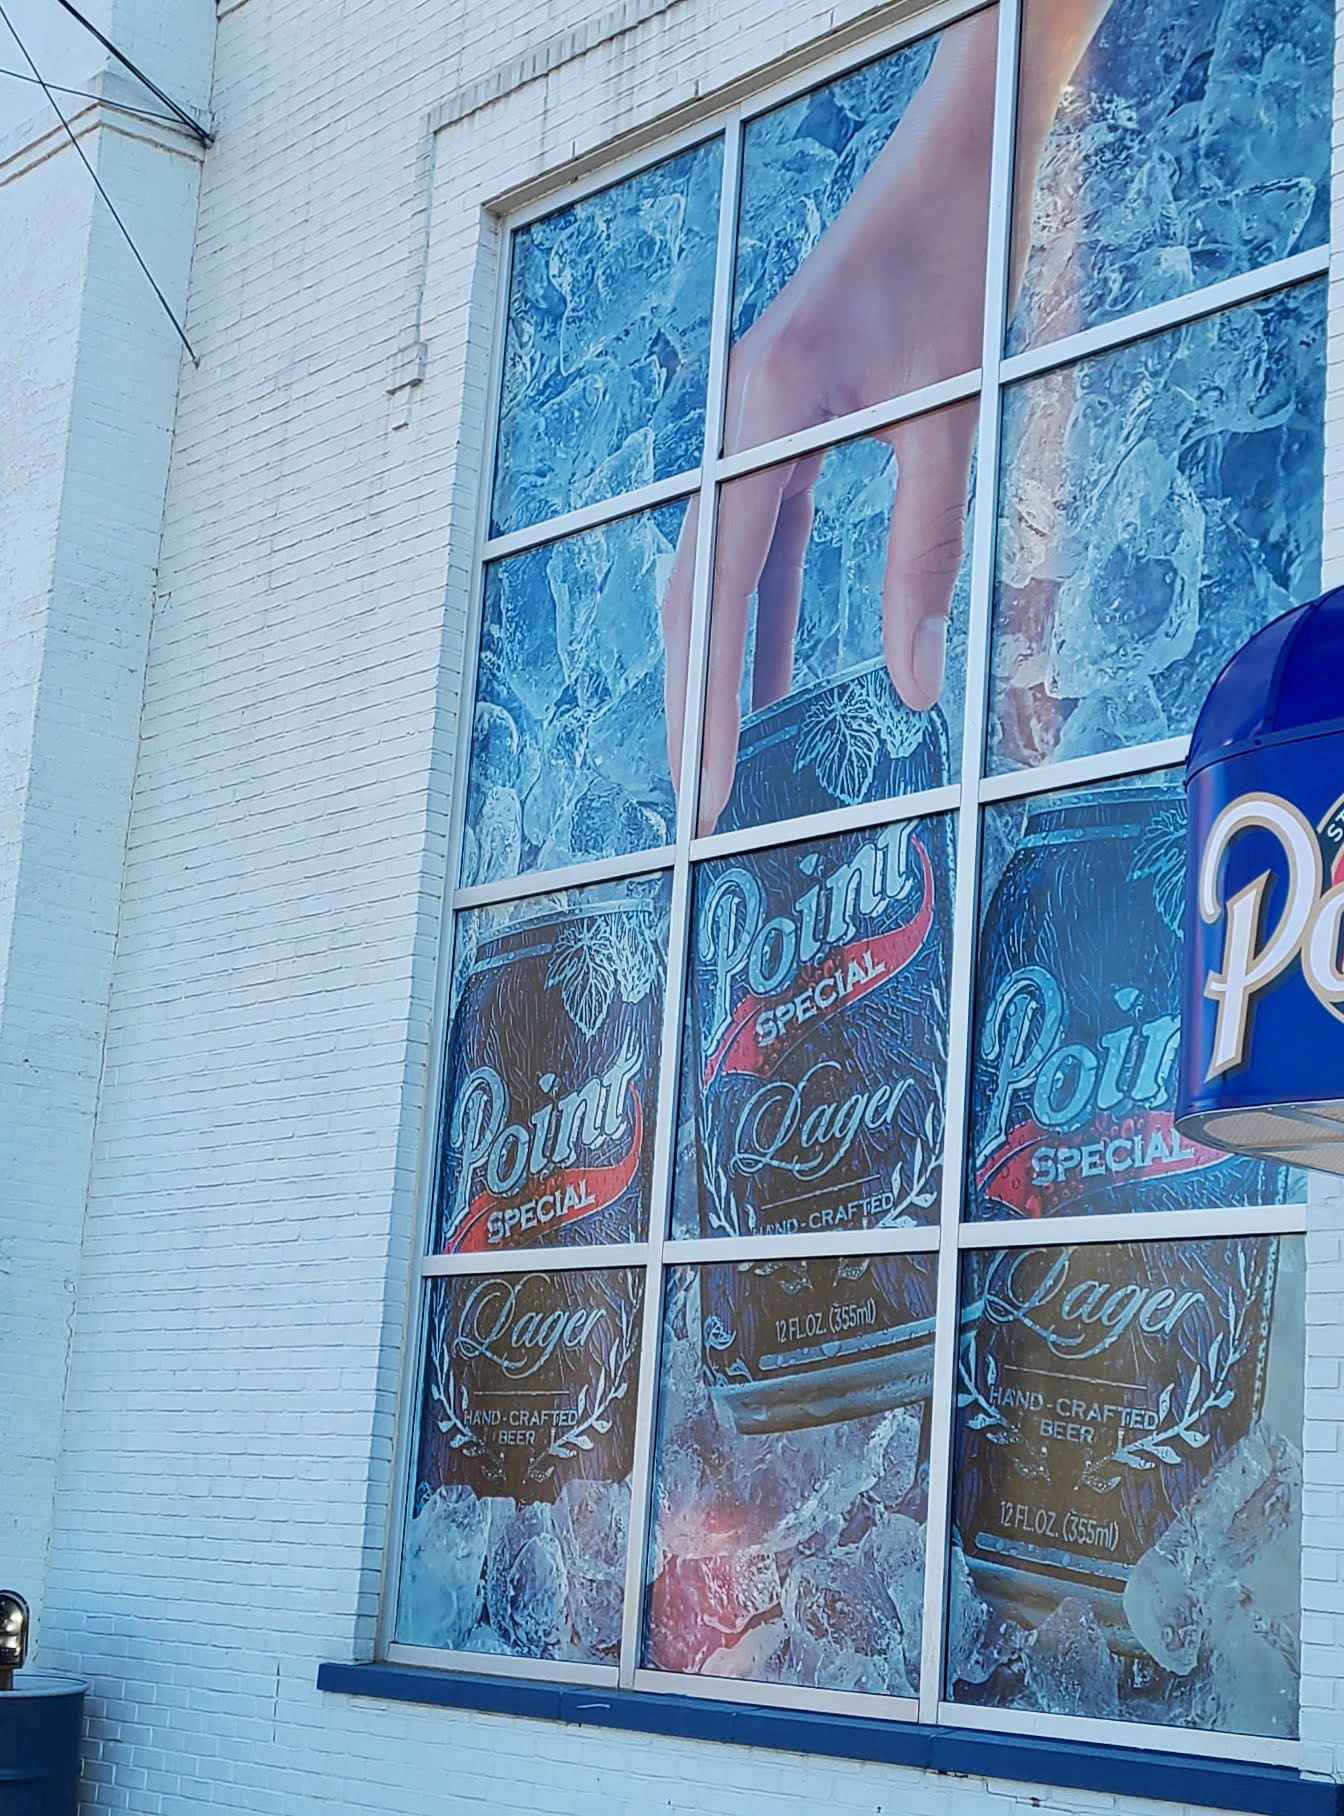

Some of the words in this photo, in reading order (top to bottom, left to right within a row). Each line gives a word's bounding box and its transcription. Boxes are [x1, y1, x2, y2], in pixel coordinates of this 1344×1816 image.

[698, 818, 921, 1056] Point
[757, 955, 887, 1047] SPECIAL
[975, 965, 1181, 1172] Poin
[444, 1027, 644, 1235] Point
[730, 1061, 914, 1180] Lager
[1032, 1129, 1195, 1186] SPECIAL
[487, 1180, 596, 1244] SPECIAL
[452, 1273, 606, 1379] Lager
[776, 1320, 787, 1343] 12
[829, 1297, 876, 1334] (355ml)
[985, 1249, 1205, 1360] Lager
[463, 1409, 578, 1427] HAND-CRAFTED
[498, 1430, 536, 1446] BEER
[989, 1385, 1160, 1431] HAND-CRAFTED
[1040, 1420, 1096, 1445] BEER
[1000, 1500, 1013, 1527] 12
[1063, 1510, 1119, 1552] (355ml)
